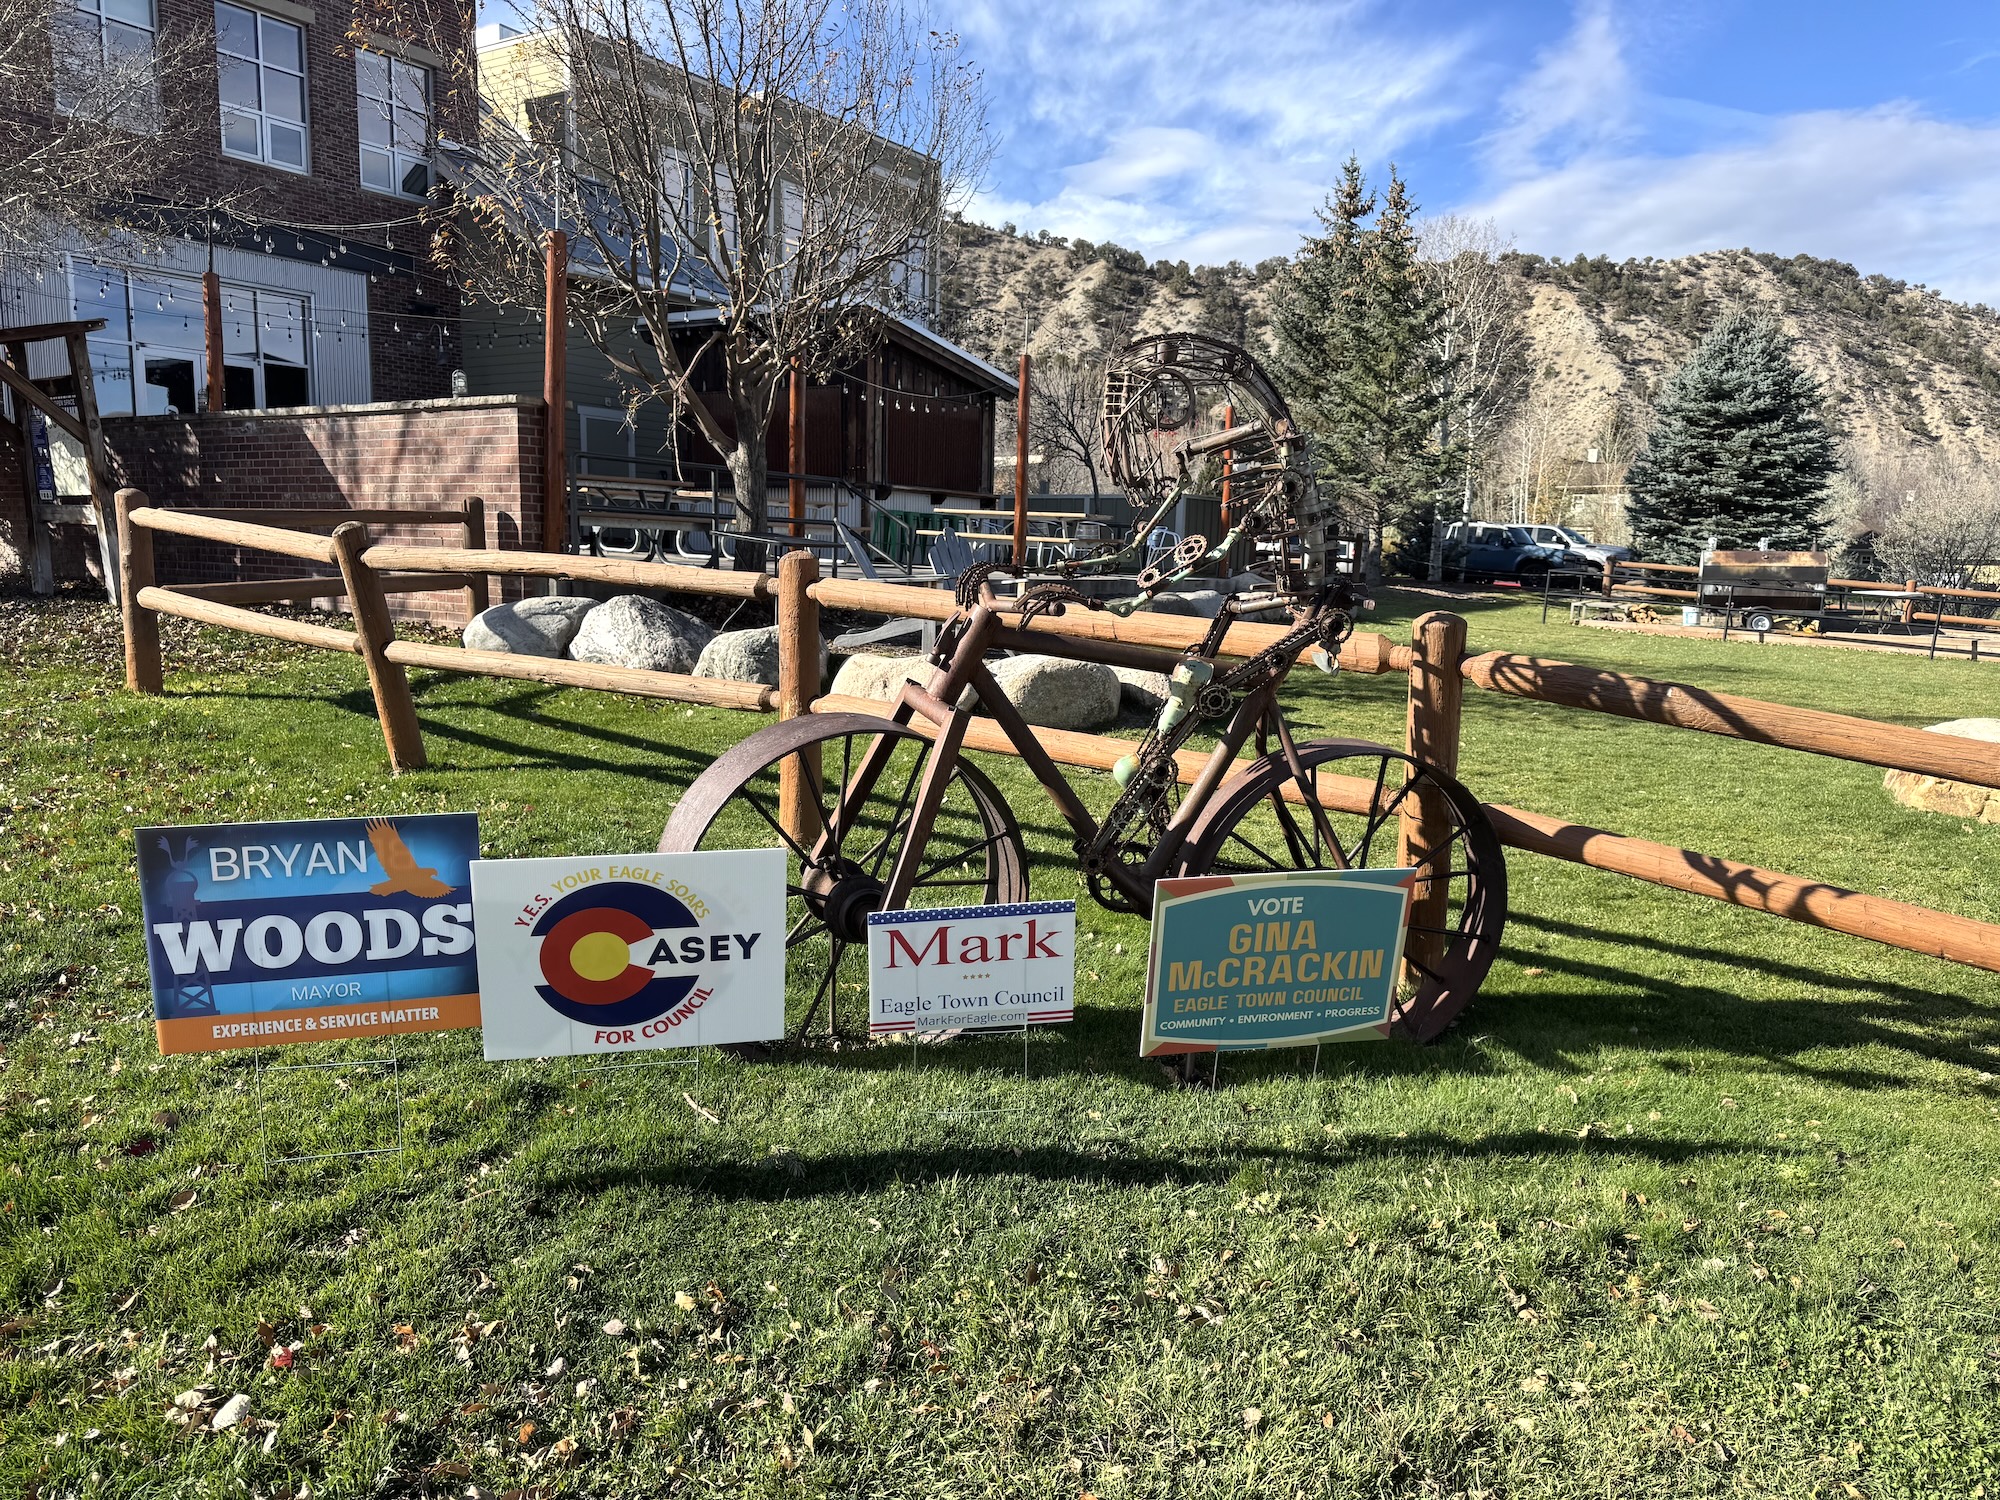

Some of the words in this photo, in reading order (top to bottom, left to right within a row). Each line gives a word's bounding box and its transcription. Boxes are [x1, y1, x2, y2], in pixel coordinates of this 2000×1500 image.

[210, 840, 368, 882] BRYAN
[514, 895, 553, 928] Y.E.S.
[551, 868, 602, 894] YOUR
[609, 865, 664, 885] EAGLE
[665, 879, 710, 920] SOARS
[1248, 896, 1304, 916] VOTE
[153, 903, 474, 975] WOODS
[882, 919, 1063, 969] Mark
[1228, 919, 1317, 954] GINA
[1168, 949, 1384, 992] McCRACKIN
[291, 982, 361, 1002] MAYOR
[880, 997, 931, 1016] Eagle
[938, 994, 988, 1009] Town
[995, 986, 1064, 1006] Council
[1173, 995, 1228, 1014] EAGLE
[1237, 991, 1286, 1008] TOWN
[1292, 987, 1364, 1005] COUNCIL
[212, 1018, 302, 1039] EXPERIENCE
[304, 1020, 317, 1030] &
[319, 1013, 378, 1029] SERVICE
[380, 1007, 439, 1023] MATTER
[594, 1029, 636, 1045] FOR
[641, 986, 714, 1039] COUNCIL
[917, 1011, 1025, 1027] MarkForEagle.com
[1159, 1016, 1226, 1030] COMMUNITY
[1237, 1010, 1313, 1024] ENVIRONMENT
[1324, 1006, 1380, 1018] PROGRESS
